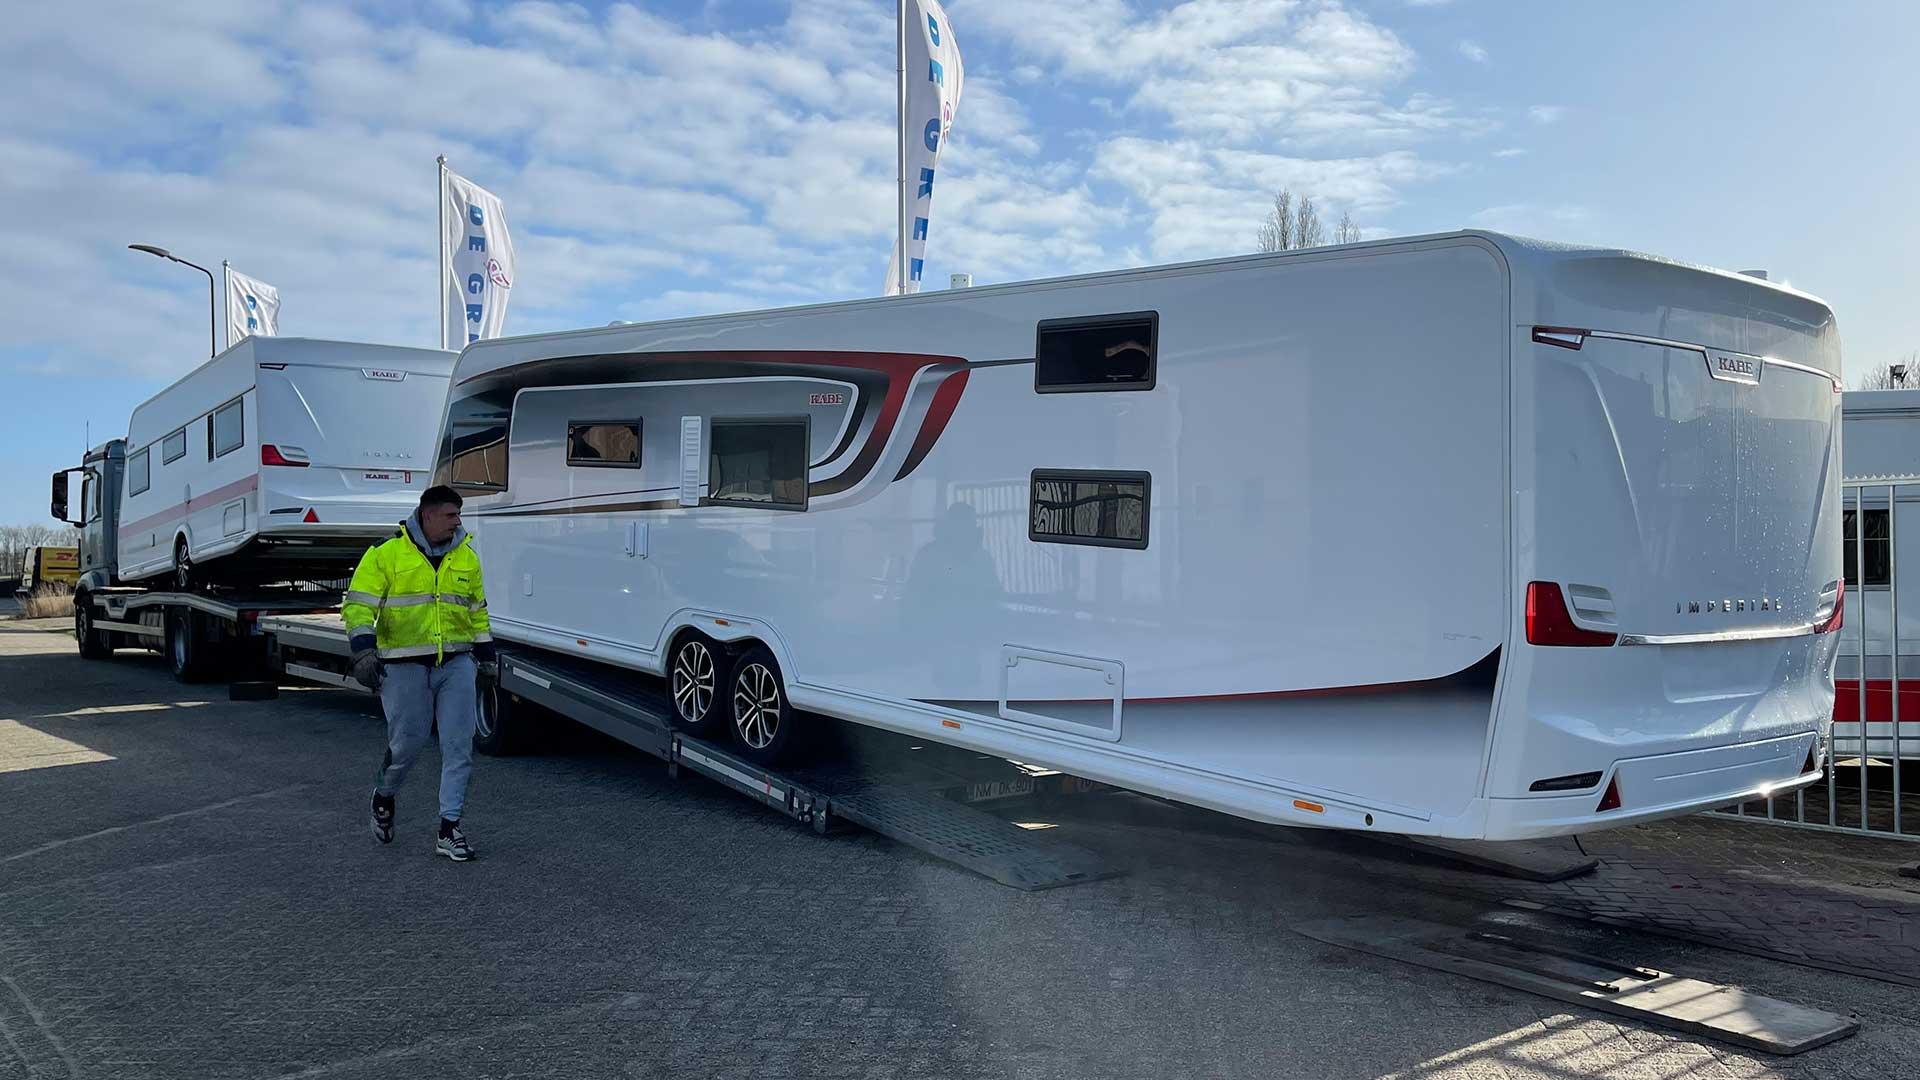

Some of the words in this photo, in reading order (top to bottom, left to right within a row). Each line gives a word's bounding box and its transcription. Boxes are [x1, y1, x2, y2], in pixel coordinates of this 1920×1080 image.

[927, 12, 944, 89] DE
[469, 204, 486, 252] DE
[1718, 356, 1753, 374] KABE
[810, 393, 844, 405] KABE
[1676, 599, 1783, 614] IMPERIAL
